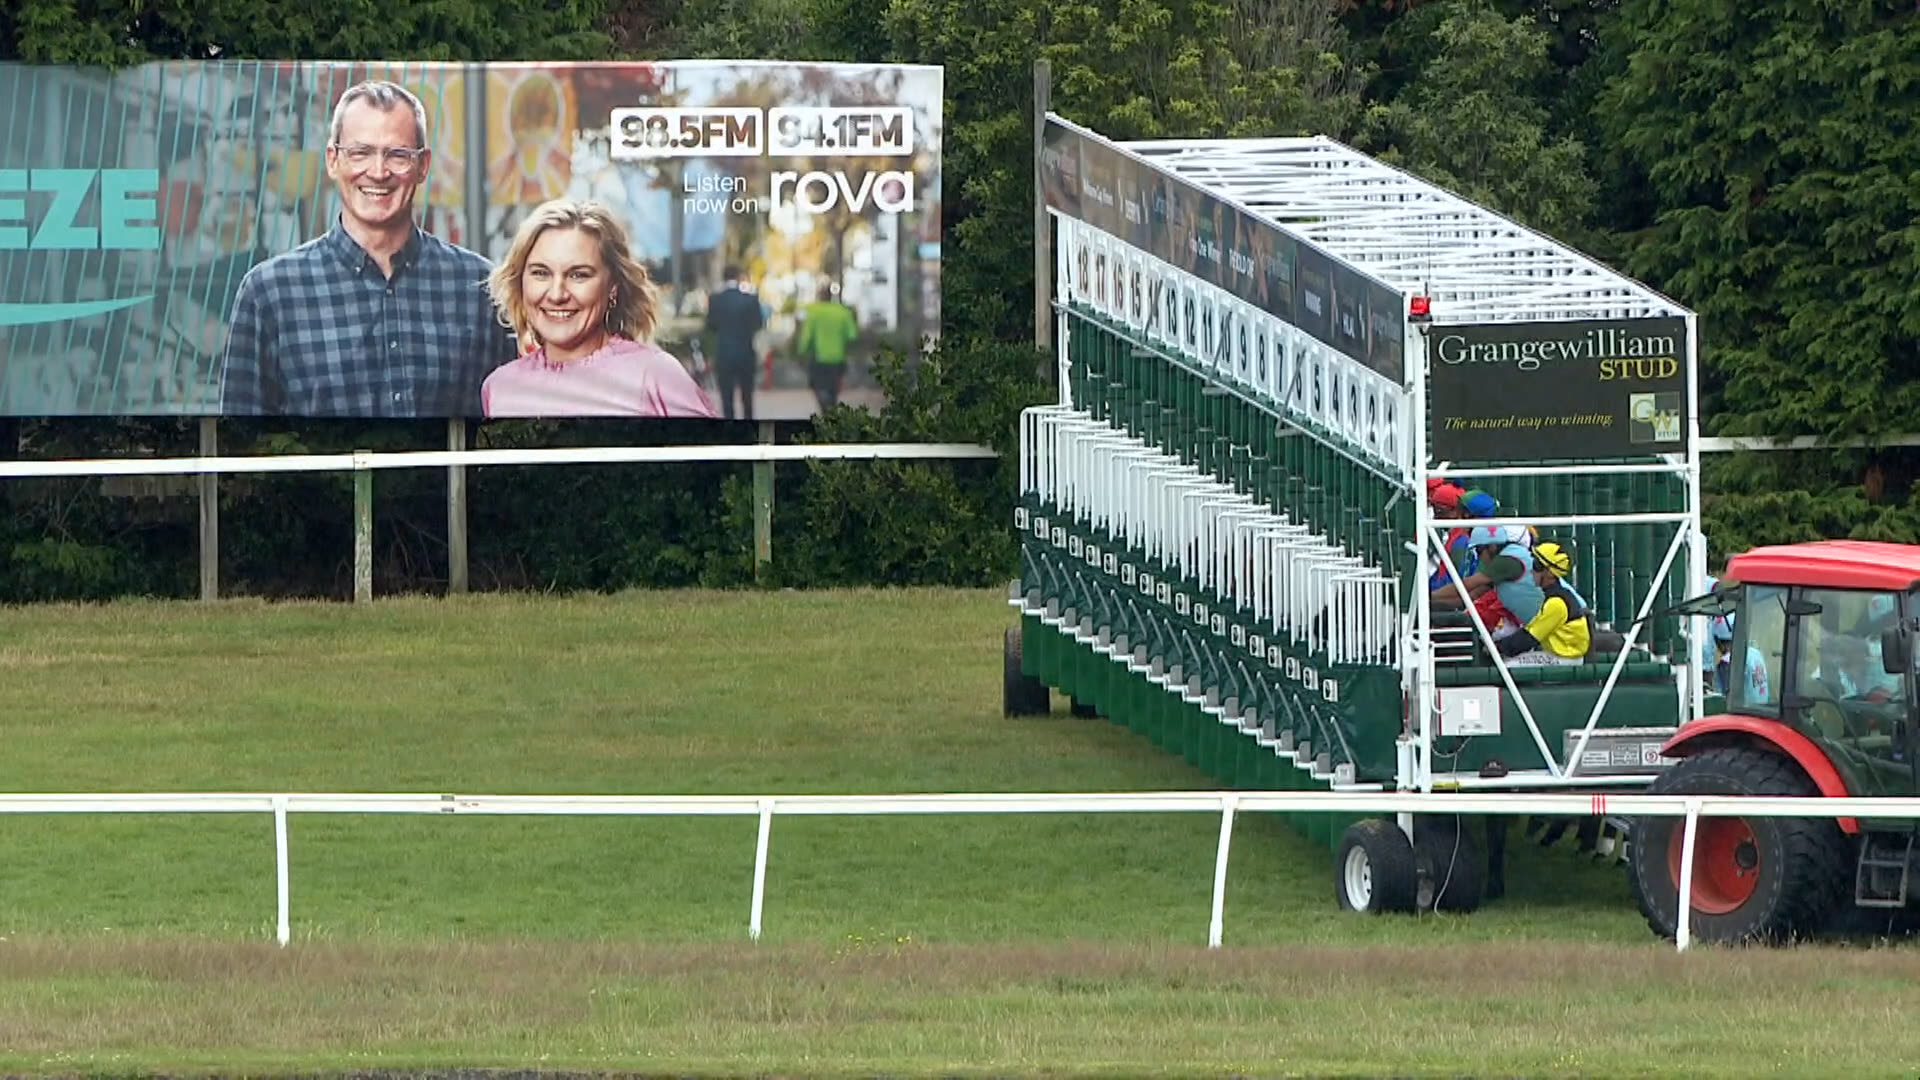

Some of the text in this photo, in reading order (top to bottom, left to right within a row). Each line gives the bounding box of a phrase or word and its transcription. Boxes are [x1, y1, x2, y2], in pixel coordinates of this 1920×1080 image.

[620, 115, 757, 148] 98.5FM
[778, 114, 904, 148] 94.1FM
[683, 173, 747, 193] Listen
[683, 198, 758, 214] now on
[771, 170, 914, 213] rova
[1078, 243, 1088, 294] 18
[1096, 252, 1105, 302] 17
[1113, 261, 1123, 311] 16
[1131, 269, 1141, 318] 15
[1167, 288, 1177, 336] 13
[1185, 297, 1195, 346] 12
[1203, 305, 1213, 355] 11
[1239, 324, 1248, 371] 9
[1258, 333, 1266, 382] 8
[1276, 343, 1284, 392] 7
[1438, 329, 1675, 370] Grangewilliam
[1600, 357, 1679, 381] STUD
[1314, 363, 1321, 412] 5
[1332, 373, 1340, 421] 4
[1350, 384, 1358, 432] 3
[1368, 394, 1376, 443] 2
[1387, 404, 1394, 452] 1
[1444, 416, 1467, 430] The
[1470, 415, 1514, 429] natural
[1517, 417, 1542, 430] way
[1545, 415, 1558, 427] to
